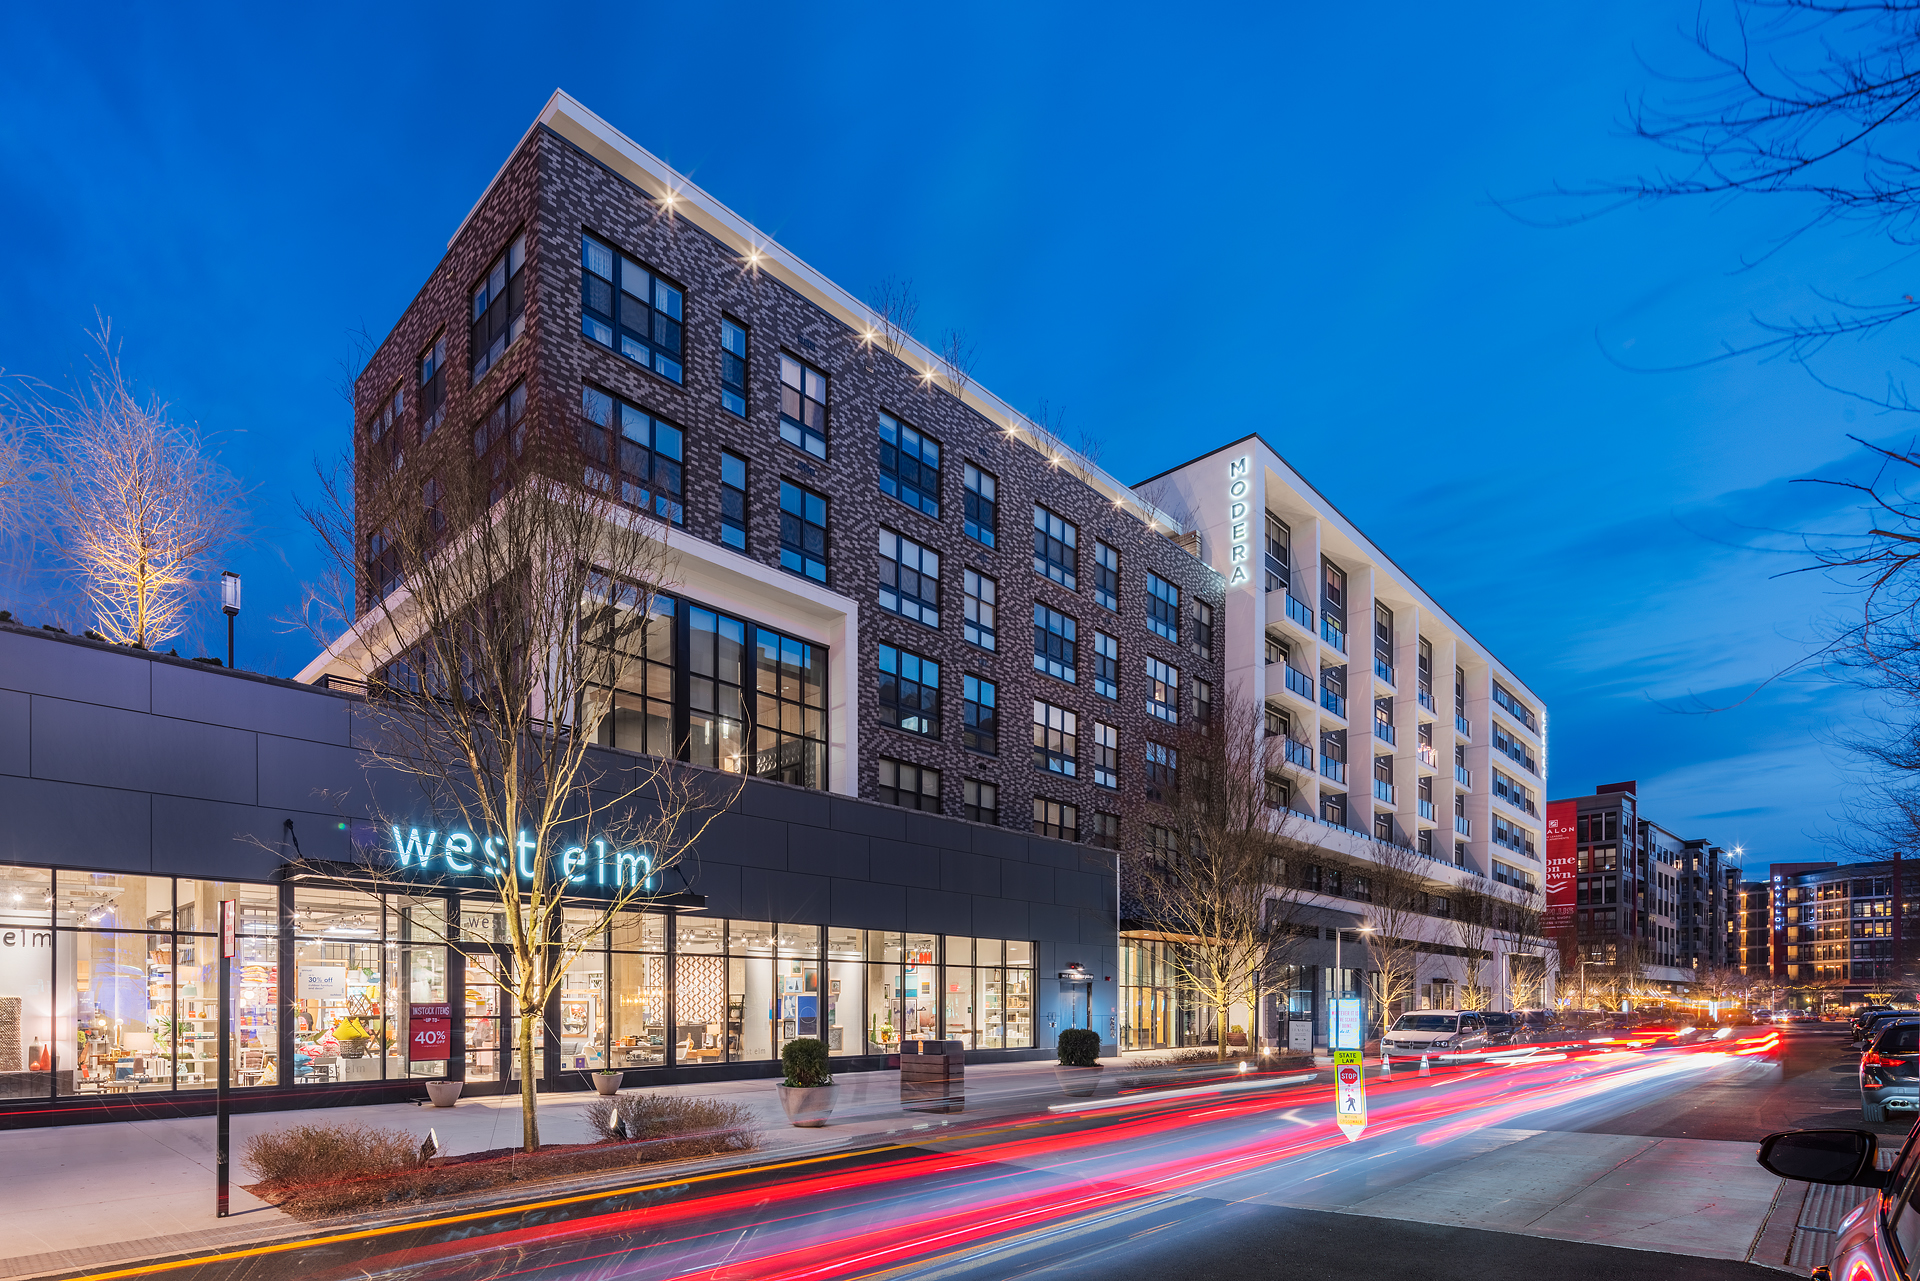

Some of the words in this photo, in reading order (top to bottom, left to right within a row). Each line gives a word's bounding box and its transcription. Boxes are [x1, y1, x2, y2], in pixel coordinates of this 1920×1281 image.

[1230, 456, 1247, 584] MODERA
[1546, 826, 1575, 834] ALON
[391, 825, 536, 879] west
[563, 840, 651, 889] elm
[1546, 856, 1576, 866] ome
[1546, 872, 1576, 880] own.
[1774, 885, 1782, 930] AVALON
[3, 929, 52, 948] elm
[435, 1006, 450, 1016] ITEMS
[414, 1030, 446, 1044] 40%
